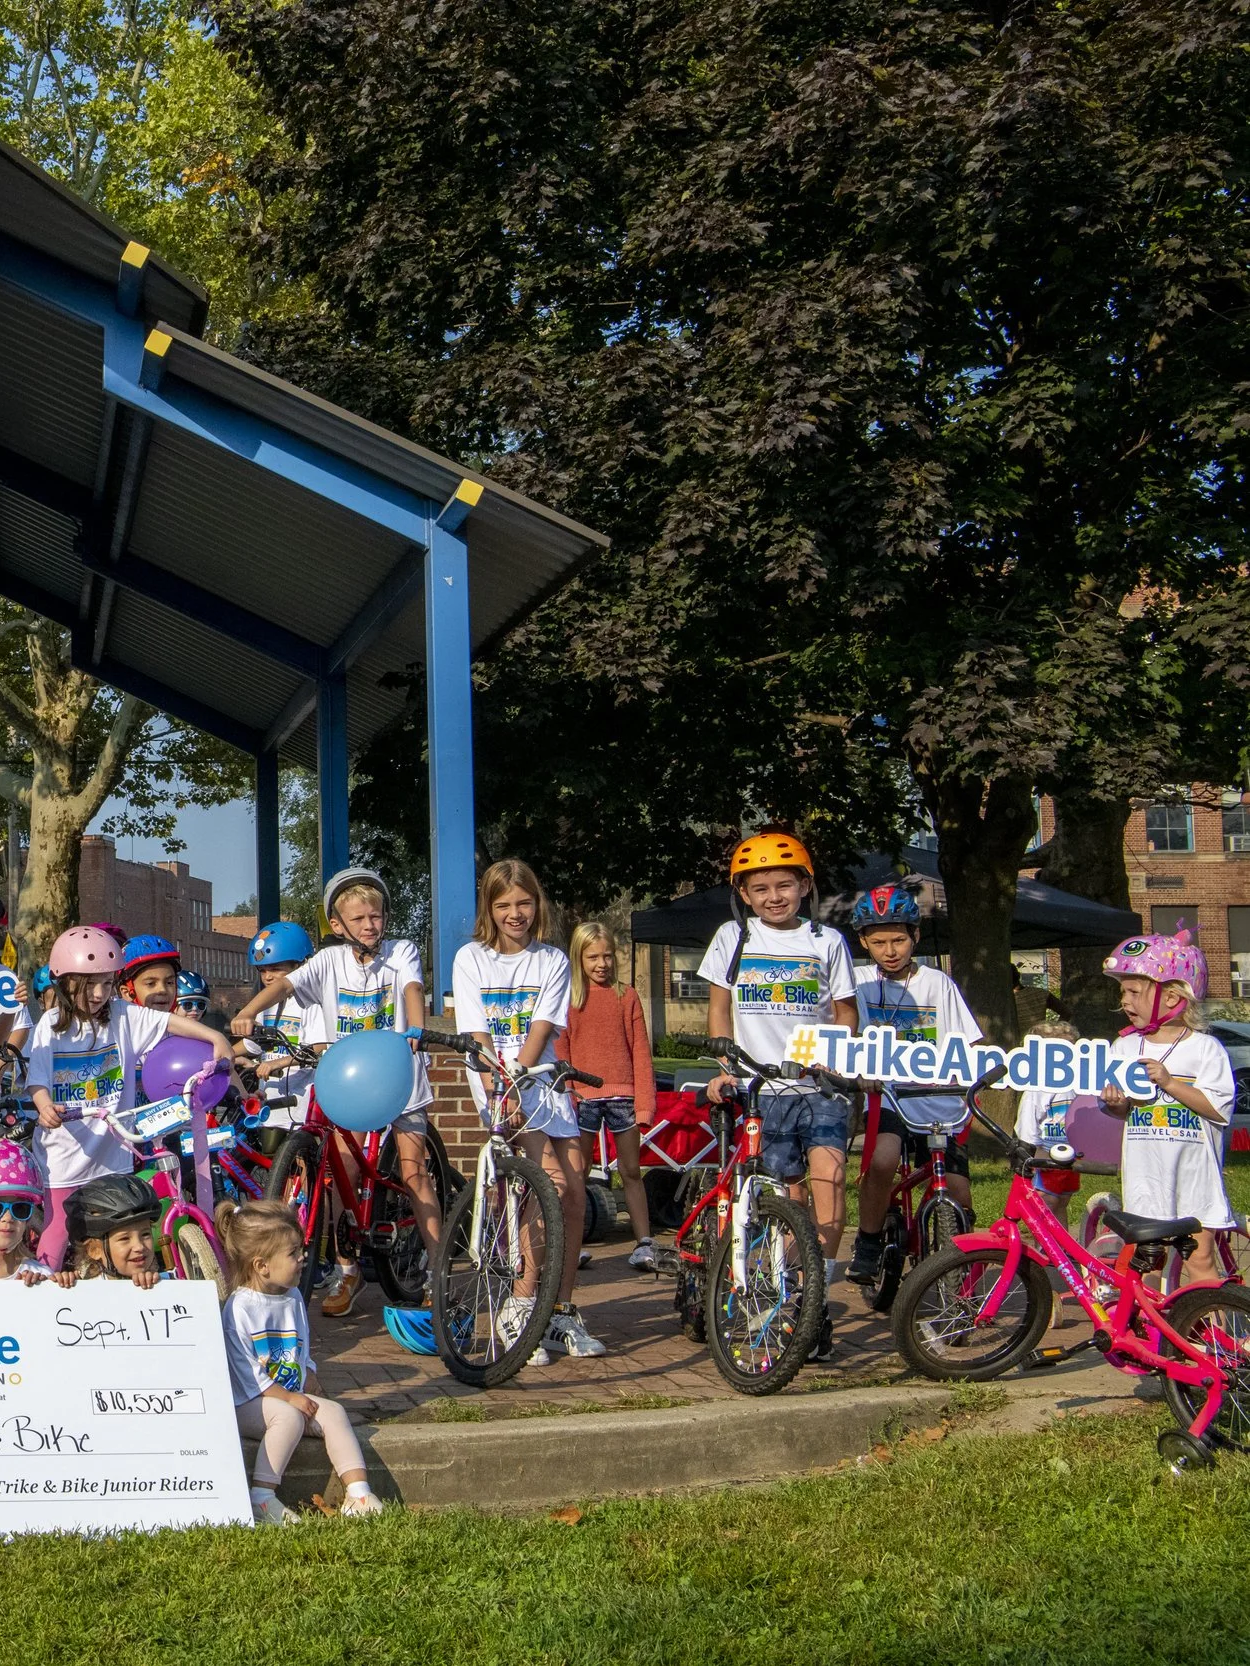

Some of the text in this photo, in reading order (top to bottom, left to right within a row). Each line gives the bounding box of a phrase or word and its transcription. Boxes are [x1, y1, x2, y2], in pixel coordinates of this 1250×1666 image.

[737, 983, 819, 1005] Trike&Bike
[789, 1028, 1152, 1095] #TrikeAndBike
[52, 1077, 125, 1102] Trike&Bike
[85, 1094, 121, 1108] VELOSAN
[55, 1308, 131, 1349] Sept.
[42, 1480, 58, 1494] &
[61, 1478, 99, 1494] Bike
[99, 1477, 157, 1496] Junior
[159, 1477, 214, 1493] Riders
